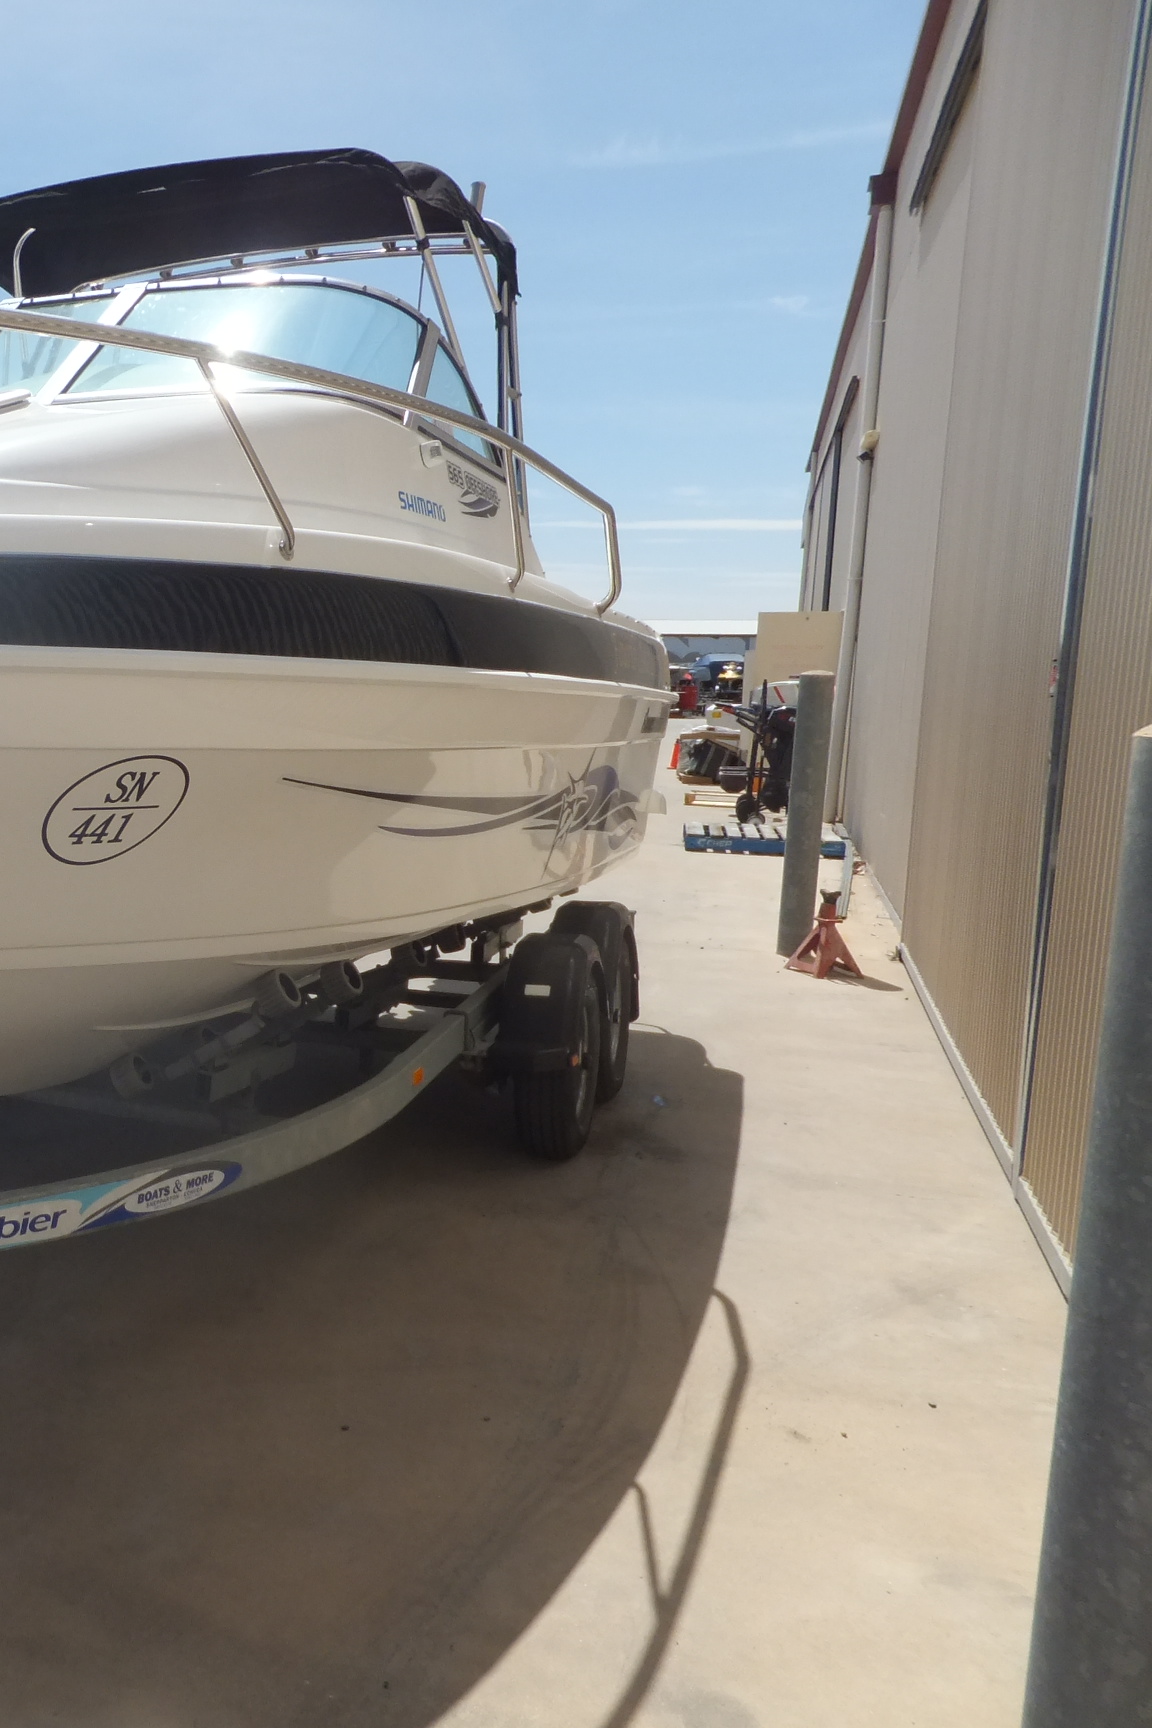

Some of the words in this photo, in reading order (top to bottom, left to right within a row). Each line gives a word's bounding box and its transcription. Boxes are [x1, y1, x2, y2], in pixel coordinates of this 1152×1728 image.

[398, 491, 446, 522] SHIMANO
[104, 771, 160, 803] SN
[68, 813, 134, 845] 441
[138, 1186, 170, 1204] BOATS
[173, 1179, 183, 1194] &
[186, 1172, 214, 1189] MORE
